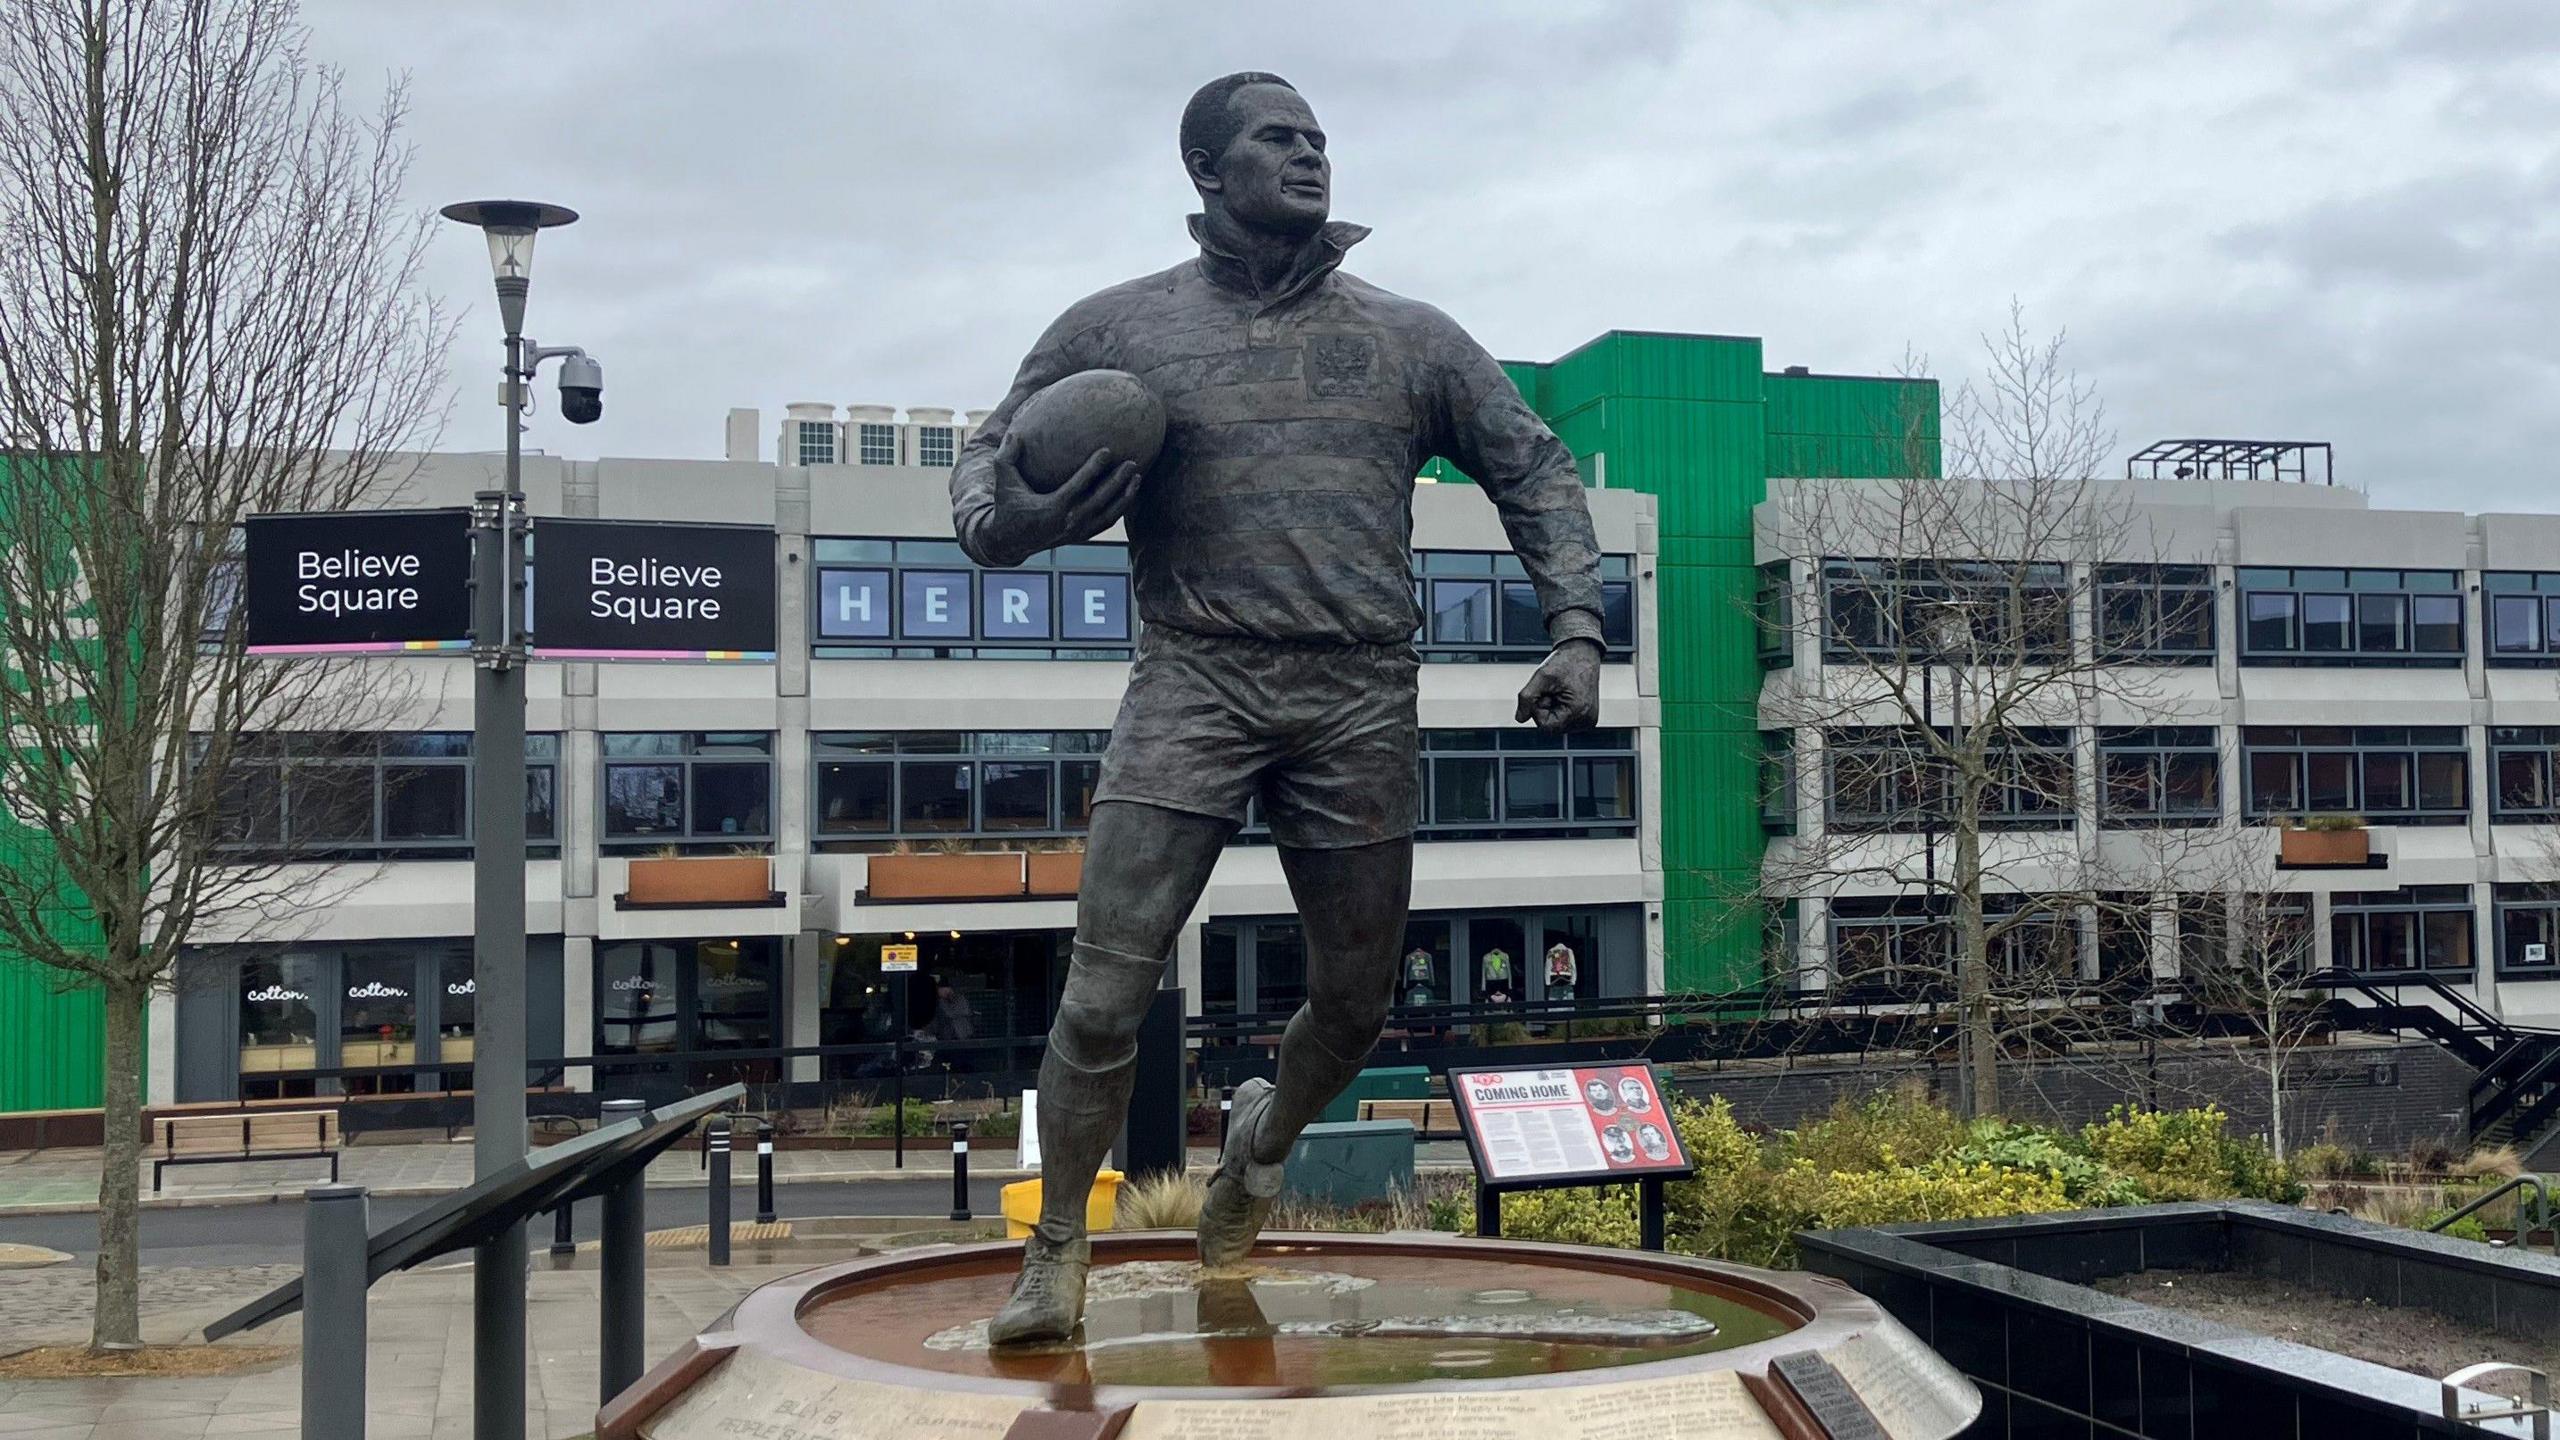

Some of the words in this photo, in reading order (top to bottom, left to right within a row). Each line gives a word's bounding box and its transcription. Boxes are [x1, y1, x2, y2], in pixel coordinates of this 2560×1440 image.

[298, 550, 421, 580] Believe
[590, 557, 722, 588] Believe
[298, 584, 420, 618] Square
[590, 590, 721, 625] Square
[448, 979, 475, 994] cot
[1474, 1086, 1528, 1101] COMING
[1530, 1084, 1570, 1098] HOME
